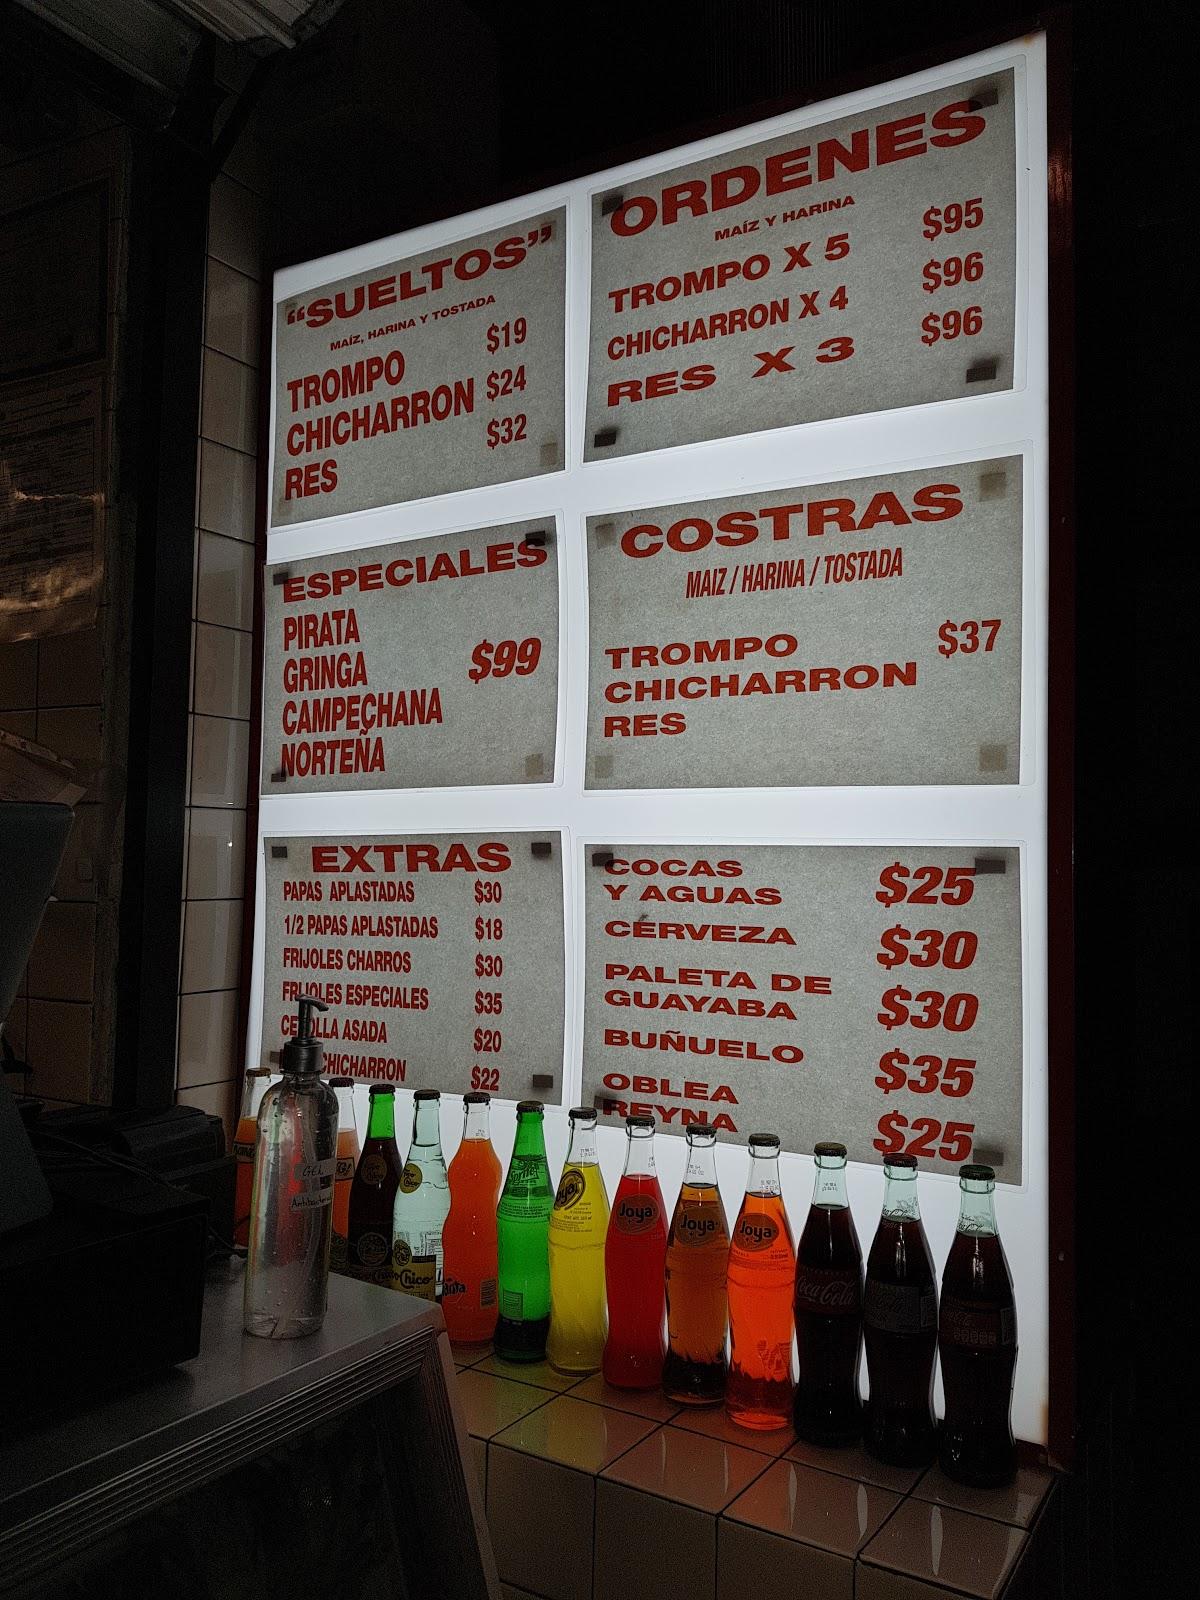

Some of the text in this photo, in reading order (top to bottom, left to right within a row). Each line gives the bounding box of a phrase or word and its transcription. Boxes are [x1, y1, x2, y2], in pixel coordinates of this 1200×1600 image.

[610, 100, 986, 237] ORDENES
[715, 195, 855, 241] MAÍZ Y HARINA
[922, 197, 984, 241] $95
[287, 225, 552, 328] “SUELTOS”
[608, 232, 850, 313] TROMPO X 5
[922, 251, 984, 293] $96
[330, 295, 496, 351] MAÍZ, HARINA Y TOSTADA
[487, 317, 527, 354] $19
[607, 285, 849, 360] CHICHARRON X 4
[921, 306, 983, 347] $96
[287, 350, 405, 412] TROMPO
[487, 365, 526, 401] $24
[607, 336, 855, 407] RES X 3
[287, 377, 474, 456] CHICHARRON
[487, 413, 527, 450] $32
[285, 459, 338, 500] RES
[620, 483, 963, 558] COSTRAS
[283, 538, 548, 603] ESPECIALES
[686, 568, 727, 598] MAIZ
[741, 558, 805, 593] HARINA
[824, 547, 903, 584] TOSTADA
[284, 608, 360, 651] PIRATA
[938, 619, 1001, 659] $37
[468, 637, 542, 684] $99
[605, 634, 798, 669] TROMPO
[283, 651, 367, 693] GRINGA
[604, 662, 917, 703] CHICHARRON
[282, 688, 442, 735] CAMPECHANA
[604, 712, 687, 737] RES
[281, 728, 385, 777] NORTEÑA
[311, 843, 511, 873] EXTRAS
[604, 858, 743, 878] COCAS
[284, 881, 415, 902] PAPAS APLASTADAS
[474, 879, 502, 906] $30
[603, 884, 782, 905] Y AGUAS
[875, 862, 977, 908] $25
[284, 915, 438, 939] 1/2 PAPAS APLASTADAS
[475, 915, 503, 942] $18
[604, 920, 797, 946] CERVEZA
[283, 948, 411, 973] FRIJOLES CHARROS
[475, 952, 503, 979] $30
[876, 925, 978, 970] $30
[346, 985, 429, 1010] ESPECIALES
[605, 964, 832, 995] PALETA DE
[474, 988, 503, 1015] $35
[604, 990, 797, 1020] GUAYABA
[877, 985, 979, 1031] $30
[342, 1019, 387, 1043] ASADA
[474, 1026, 502, 1054] $20
[604, 1029, 804, 1063] BUÑUELO
[471, 1065, 500, 1091] $22
[602, 1073, 739, 1105] OBLEA
[874, 1048, 976, 1098] $35
[602, 1099, 739, 1133] REYNA
[873, 1110, 975, 1161] $25
[556, 1182, 578, 1205] oya
[619, 1202, 654, 1223] Joya
[680, 1214, 716, 1236] Joya
[740, 1221, 772, 1243] Joya
[400, 1269, 433, 1289] Chico
